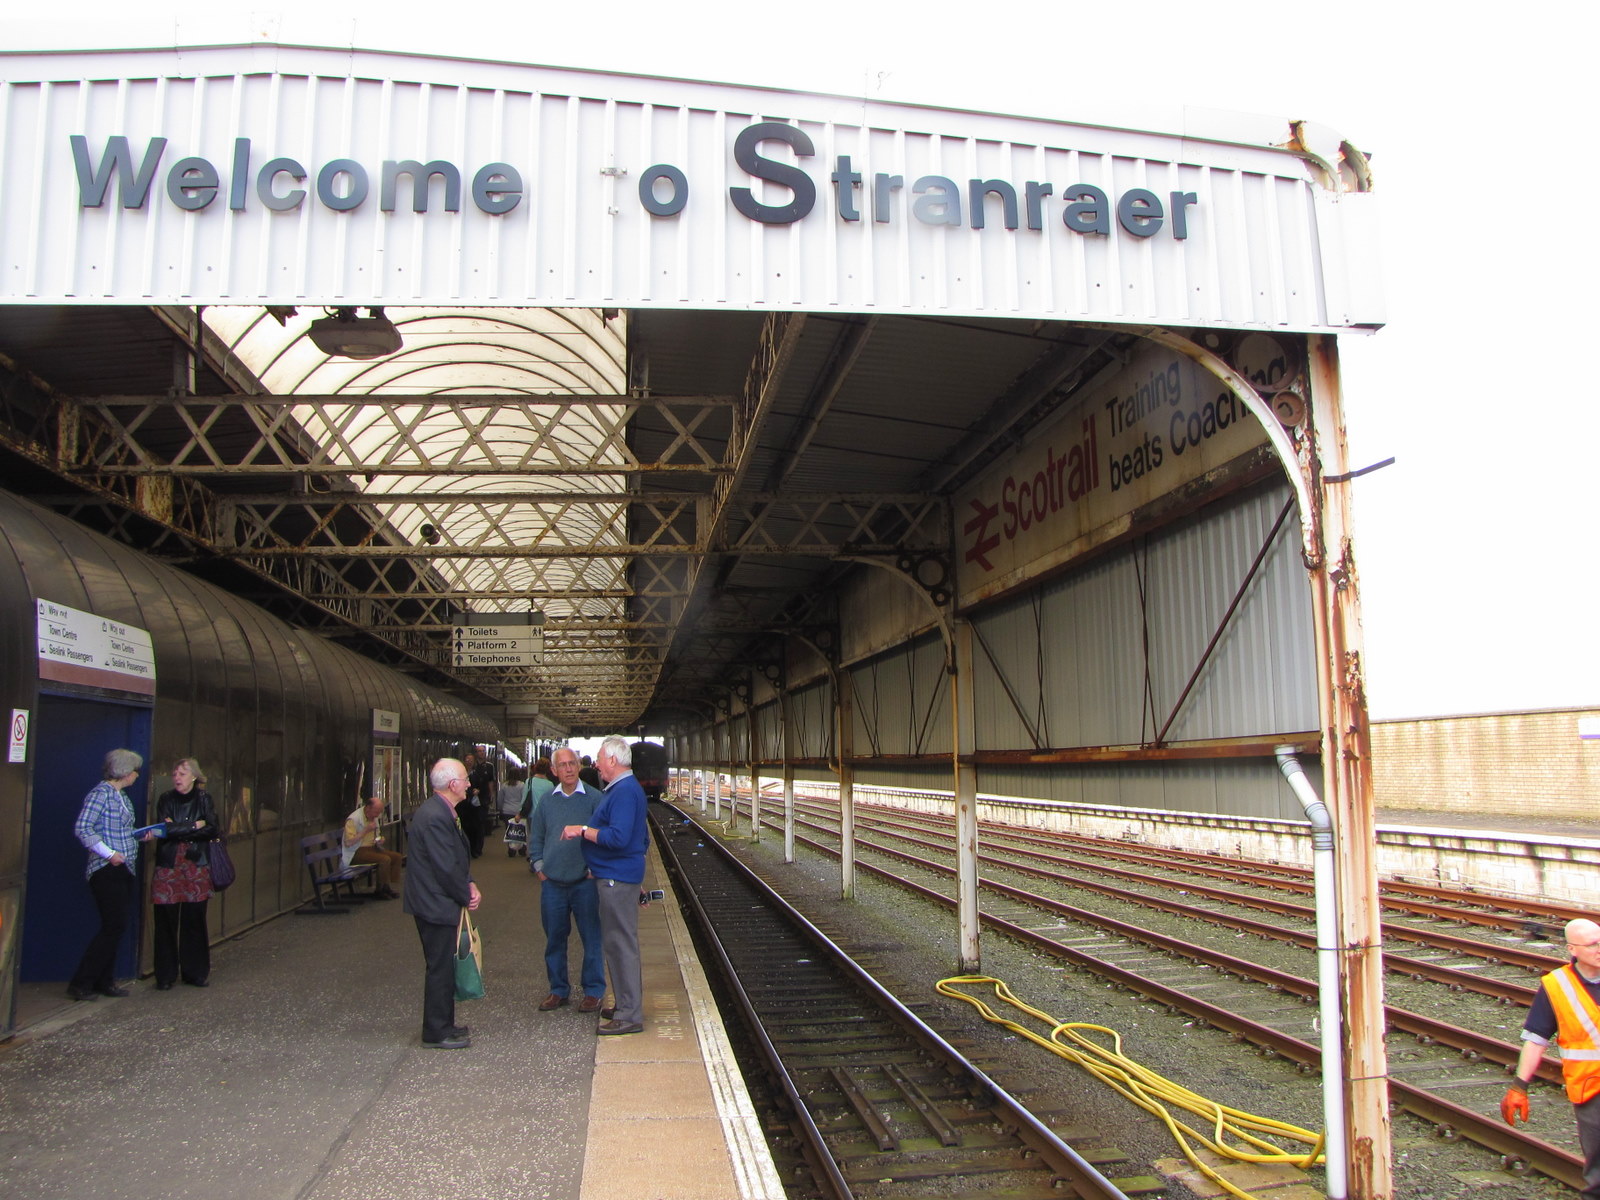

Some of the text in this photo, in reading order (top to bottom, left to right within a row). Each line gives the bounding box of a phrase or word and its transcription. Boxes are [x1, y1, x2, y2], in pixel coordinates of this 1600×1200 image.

[70, 135, 524, 216] Welcome
[728, 122, 1198, 241] Stranraer
[1106, 361, 1181, 438] Training
[1108, 355, 1285, 492] beats Coachg
[1003, 414, 1099, 540] Scotrail
[48, 624, 78, 640] Town Centre
[109, 623, 118, 634] Way
[468, 627, 498, 636] Toilets
[110, 639, 135, 654] Town Centre
[467, 640, 517, 649] Platform 2
[48, 643, 94, 663] Sealink Passengers
[468, 654, 521, 663] Telephones
[111, 657, 148, 674] Sealink Passengers
